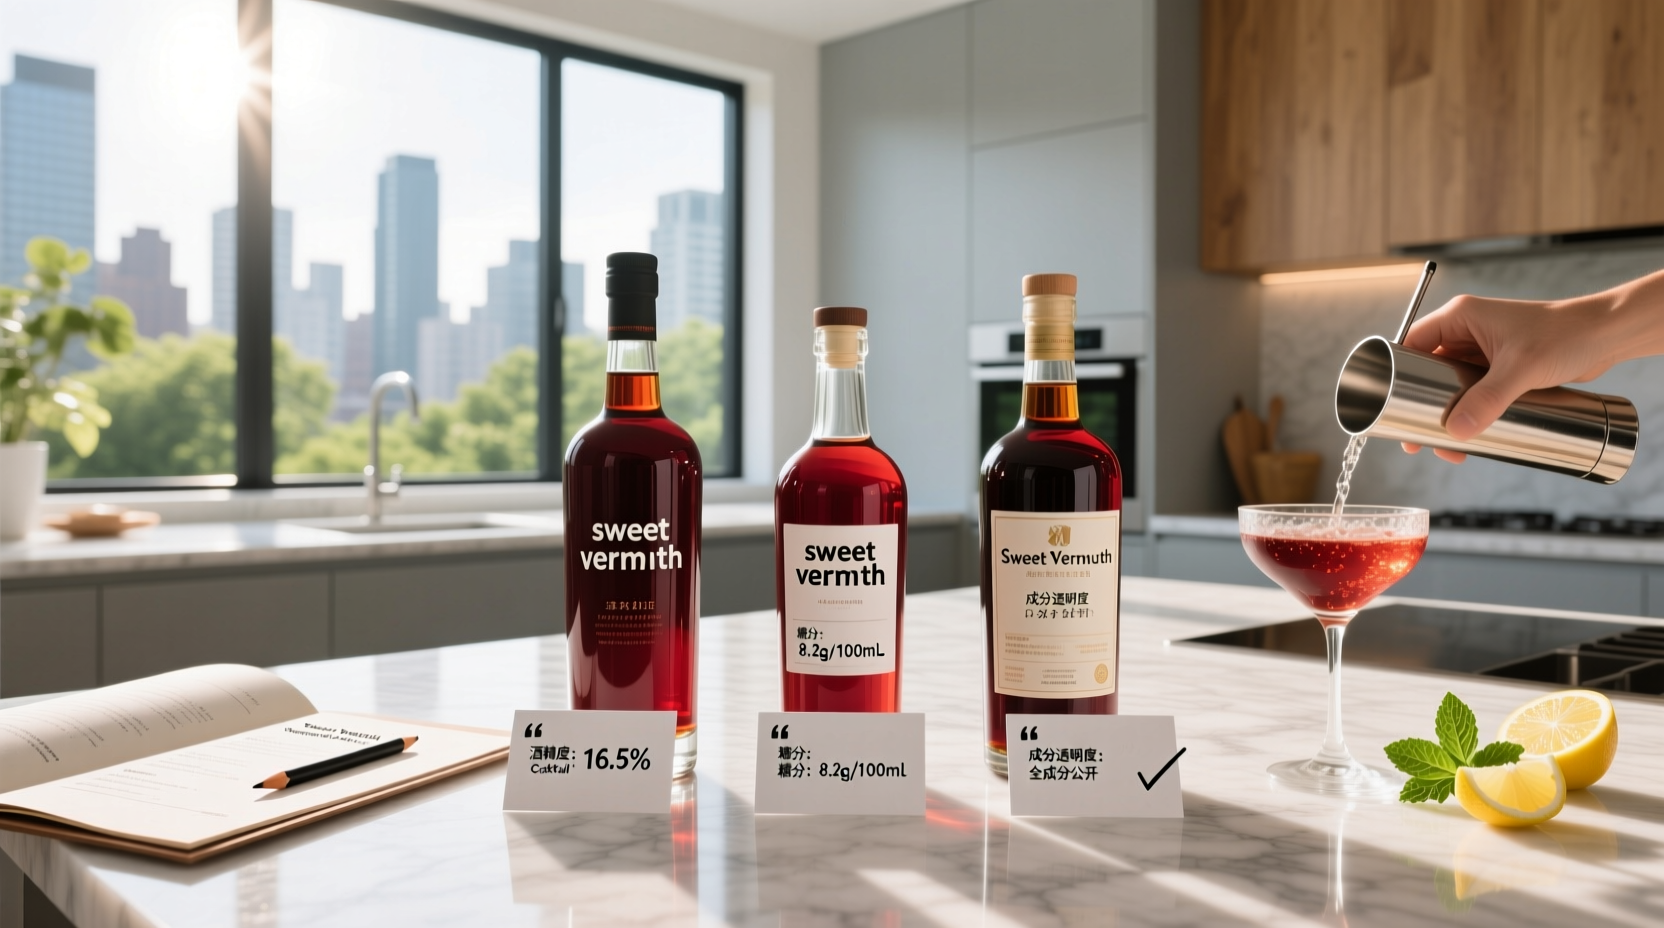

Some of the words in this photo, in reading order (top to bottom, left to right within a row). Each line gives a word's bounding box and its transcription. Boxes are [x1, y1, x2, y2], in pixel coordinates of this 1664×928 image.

[592, 518, 670, 541] sweet
[804, 541, 876, 562] sweet
[1001, 548, 1047, 566] Sweet
[796, 563, 886, 586] vermth
[798, 642, 885, 662] 8.2g/100mL
[584, 747, 651, 771] 16.5%
